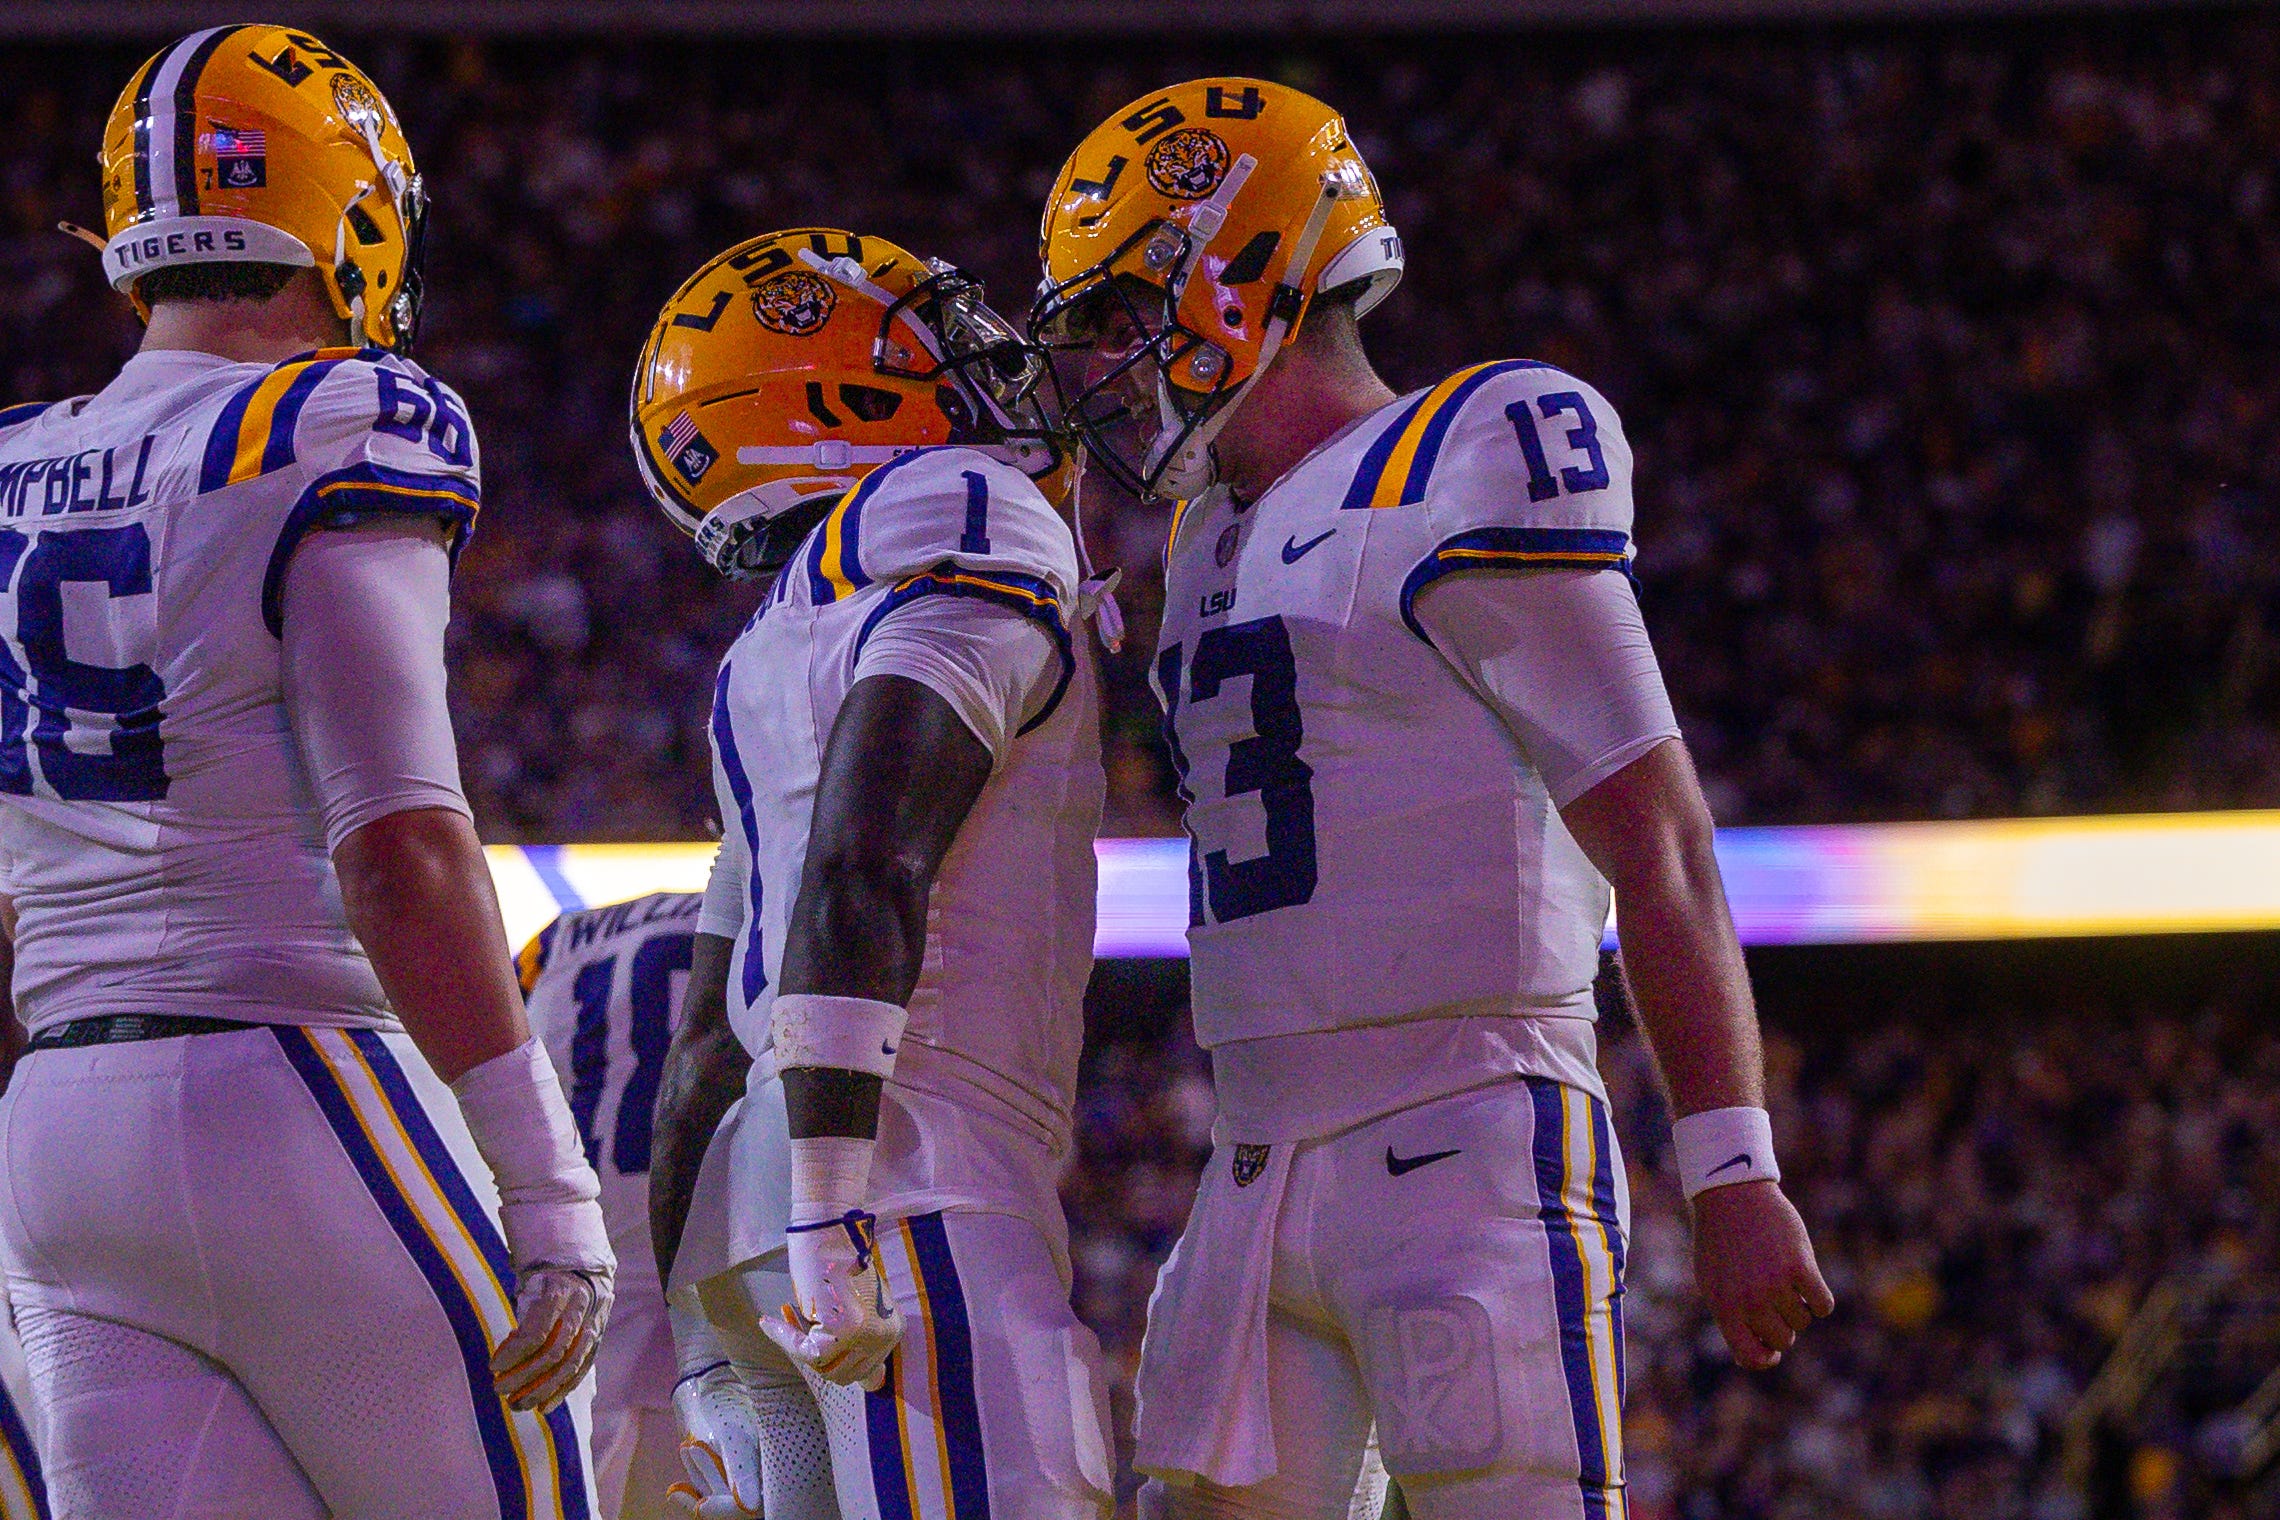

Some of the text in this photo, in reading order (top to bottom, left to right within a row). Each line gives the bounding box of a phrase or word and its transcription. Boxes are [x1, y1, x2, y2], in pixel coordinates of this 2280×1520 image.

[1071, 86, 1260, 200] LSU
[114, 229, 247, 268] TIGERS
[672, 232, 864, 333] LSU
[372, 366, 474, 468] 66
[1504, 391, 1610, 503] 13
[960, 469, 992, 556] 1
[1200, 587, 1238, 618] LSU
